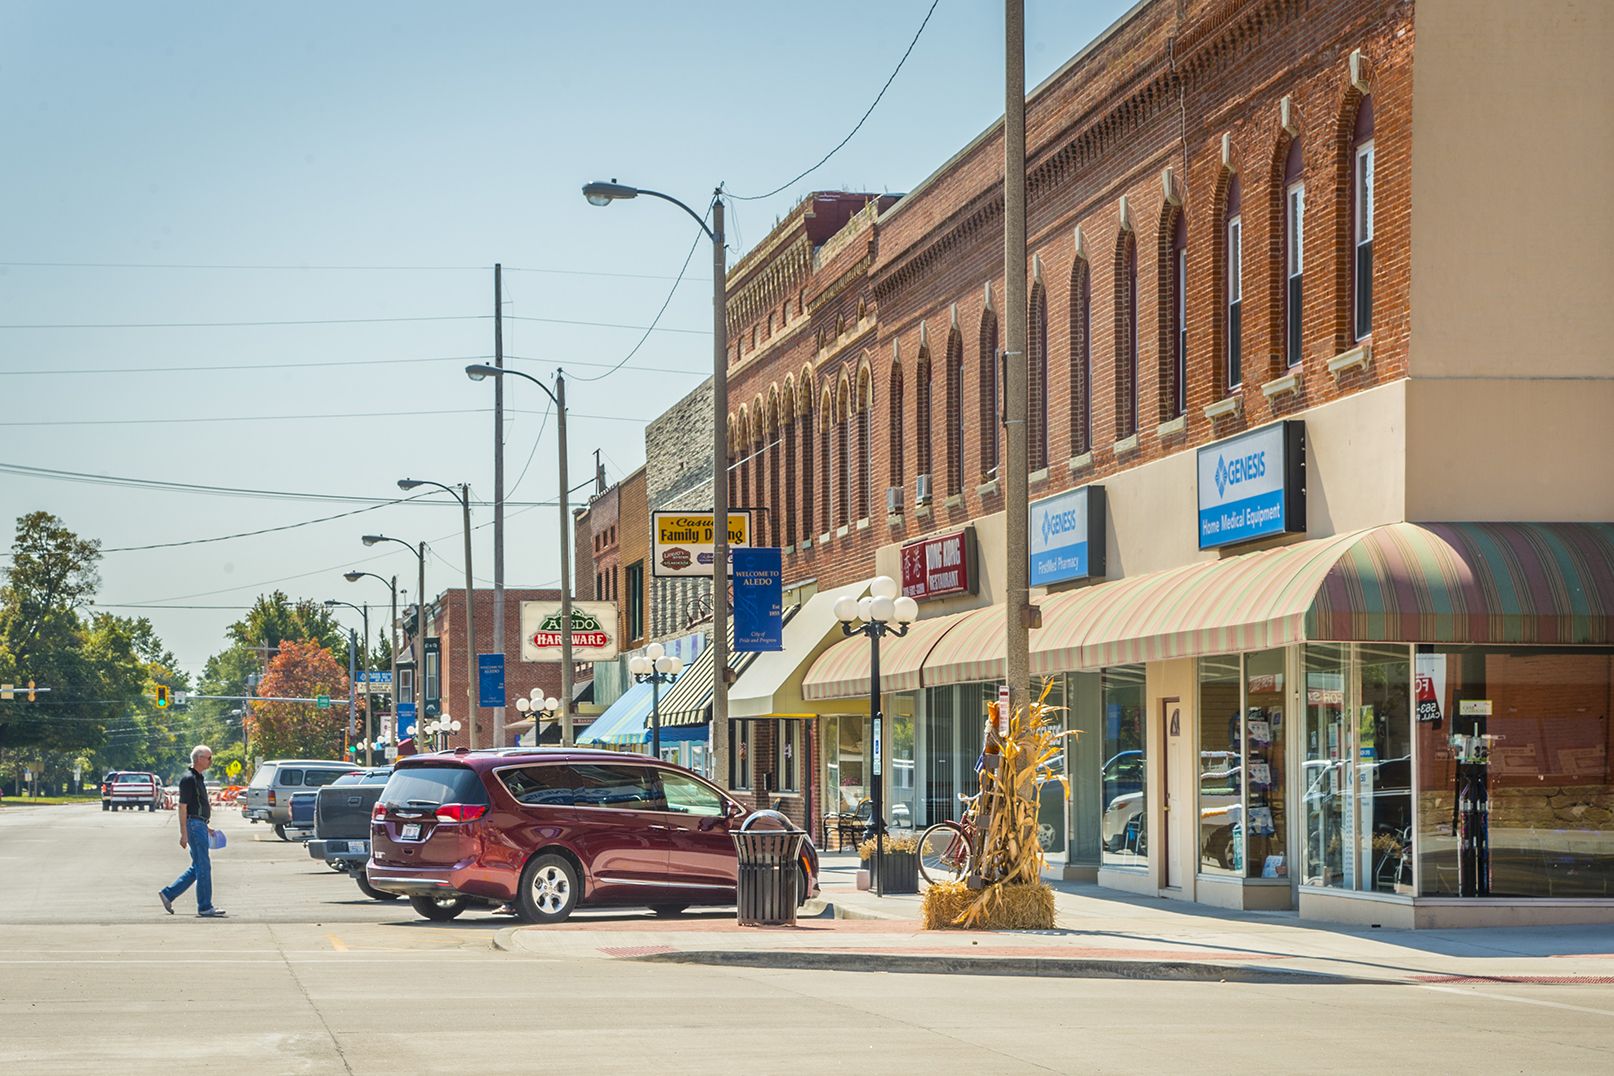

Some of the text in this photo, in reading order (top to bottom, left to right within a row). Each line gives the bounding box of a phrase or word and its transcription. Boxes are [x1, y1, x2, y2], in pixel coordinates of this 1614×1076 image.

[1228, 451, 1266, 485] GENESIS
[676, 518, 714, 527] Casu
[1051, 510, 1076, 535] GENESIS
[1203, 502, 1281, 536] Home Medical Equipment
[661, 528, 743, 545] Family Dng
[1058, 556, 1079, 571] Pharmacy
[743, 578, 772, 586] ALEDO
[546, 619, 595, 630] AEDO
[537, 634, 604, 645] HARWARE
